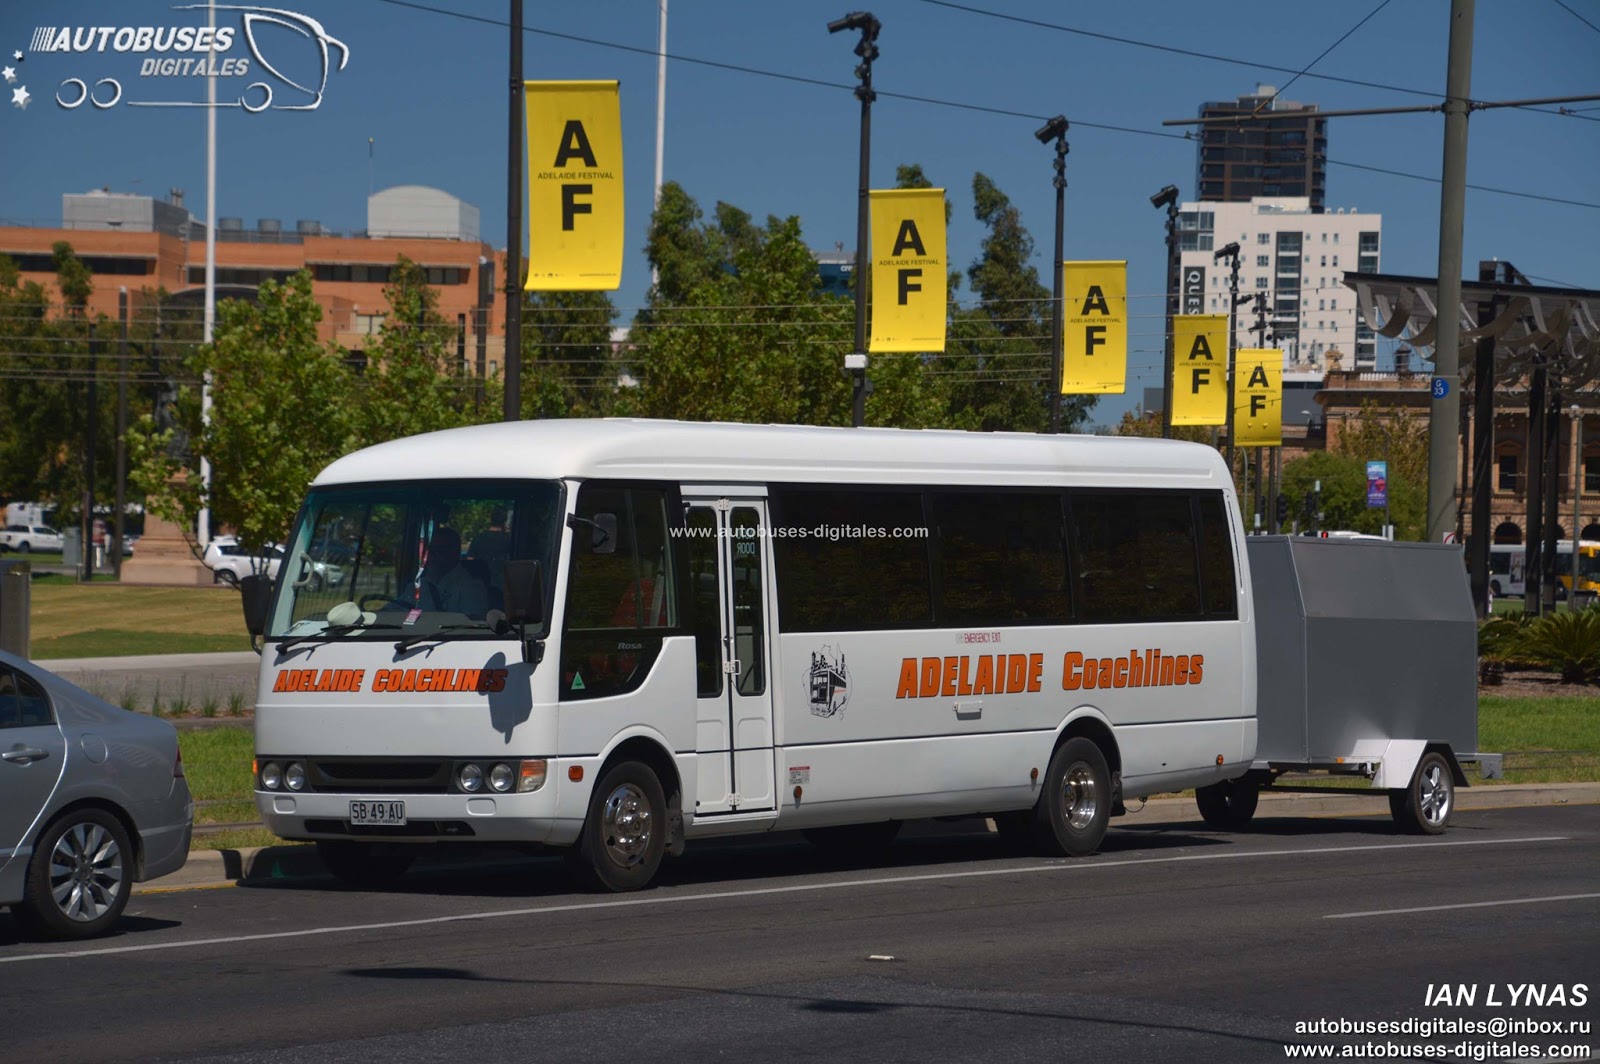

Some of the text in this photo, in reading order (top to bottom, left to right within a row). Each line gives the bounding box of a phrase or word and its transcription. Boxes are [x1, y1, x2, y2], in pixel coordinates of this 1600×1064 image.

[553, 119, 598, 168] A
[537, 171, 615, 180] ADELAIDE FESTIVAL
[561, 184, 593, 231] F
[891, 219, 927, 257] A
[897, 268, 923, 306] F
[1080, 285, 1111, 316] A
[1085, 325, 1107, 356] F
[1188, 334, 1214, 361] A
[1192, 368, 1211, 394] F
[1247, 365, 1270, 388] A
[1250, 395, 1267, 417] F
[617, 642, 642, 650] Rosa
[964, 632, 990, 644] EMERGENCY
[272, 668, 508, 693] ADELAIDE COACHLINES
[896, 648, 1204, 700] ADELAIDE Coachlines
